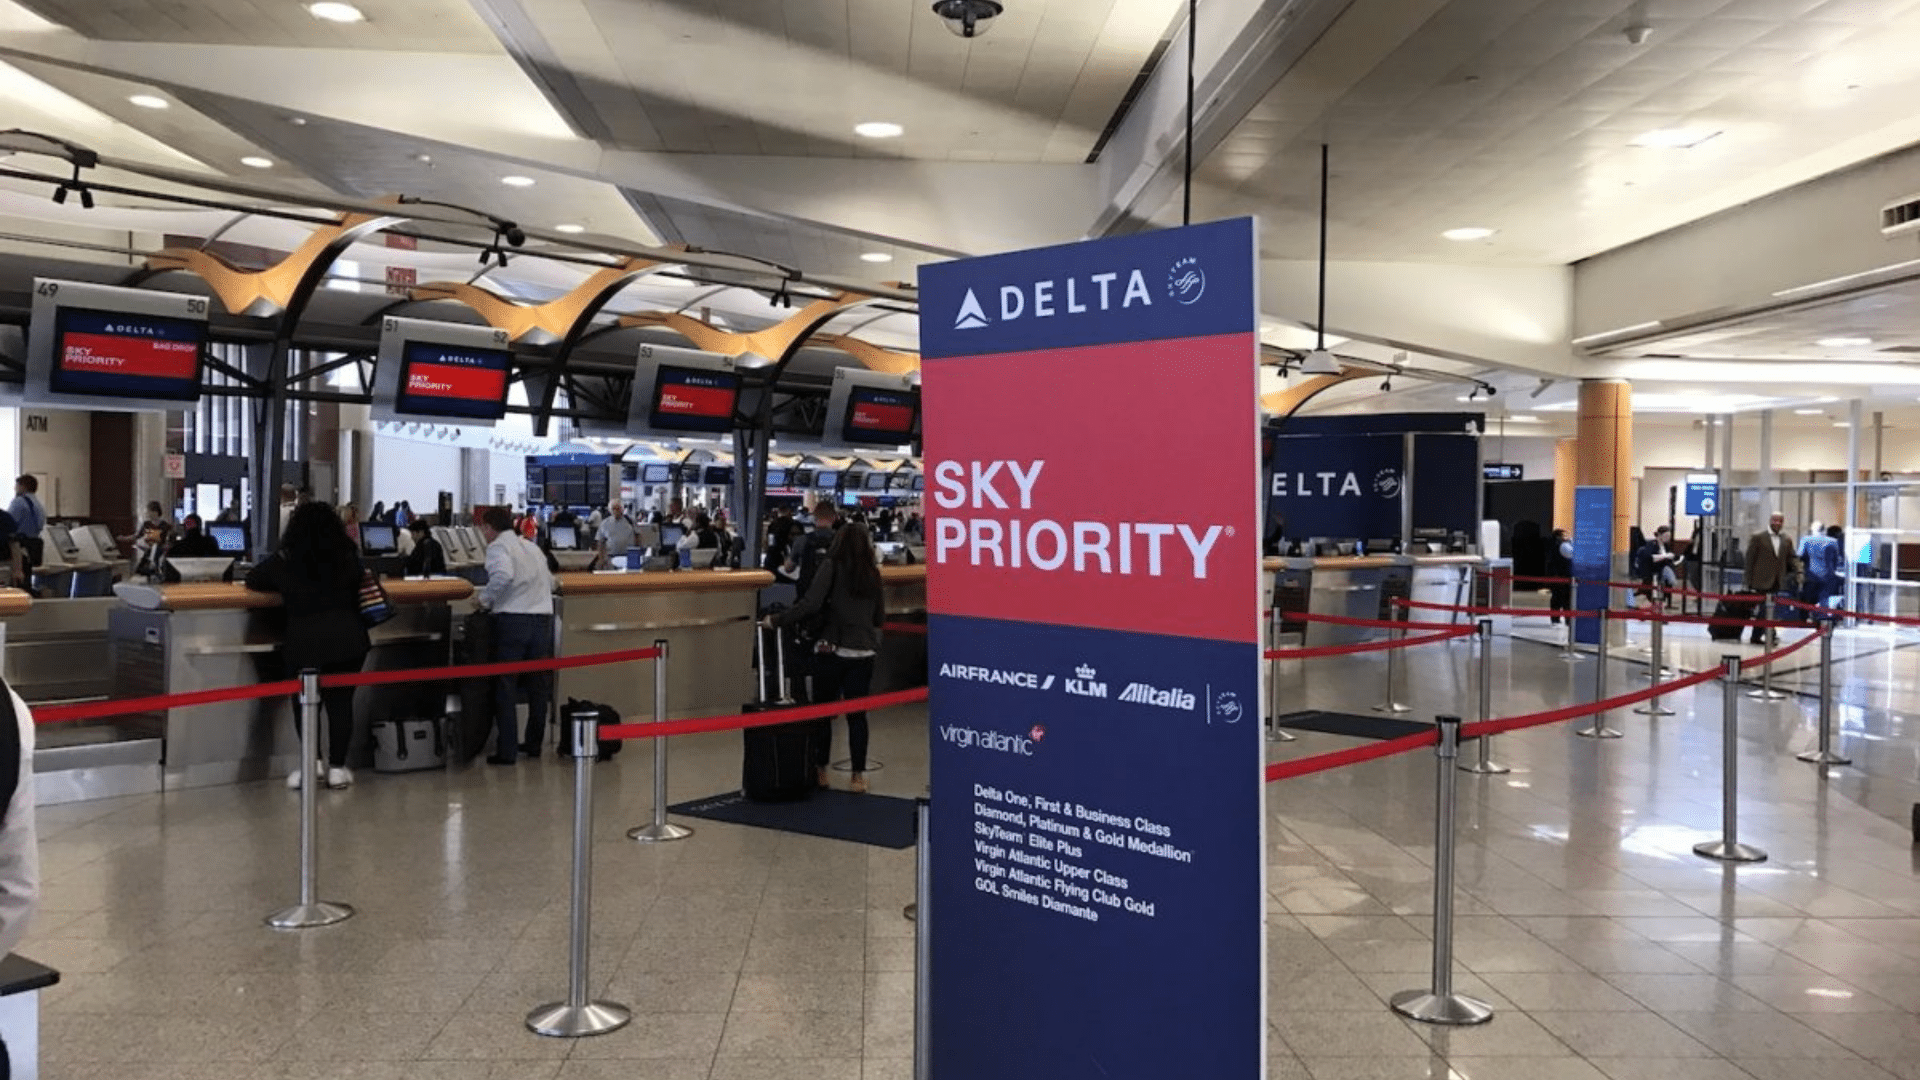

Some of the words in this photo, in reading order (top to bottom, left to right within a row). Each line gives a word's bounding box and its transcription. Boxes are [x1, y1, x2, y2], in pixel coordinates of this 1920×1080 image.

[37, 283, 59, 298] 49
[1000, 269, 1152, 320] DELTA
[187, 299, 206, 314] 50
[116, 325, 154, 335] DELTA
[385, 319, 399, 333] 51
[493, 331, 508, 343] 52
[64, 355, 125, 367] PRIORITY
[65, 346, 93, 356] SKY
[447, 355, 475, 365] DELTA
[26, 415, 48, 432] ATM
[934, 459, 1045, 509] SKY
[1271, 472, 1362, 496] ELTA
[935, 518, 1224, 579] PRIORITY
[1065, 678, 1108, 698] KLM
[1118, 682, 1196, 711] Alitalia
[974, 783, 1003, 801] Delta
[1035, 796, 1061, 814] First
[1063, 802, 1073, 817] &
[1075, 804, 1131, 829] Business
[1134, 817, 1171, 837] Class
[974, 802, 1027, 828] Diamond,
[1029, 813, 1080, 838] Platinum
[1083, 826, 1092, 841] &
[1095, 829, 1125, 848] Gold
[1127, 836, 1192, 863] Medallion
[974, 821, 1023, 844] SkyTeam
[1028, 833, 1054, 851] Elite
[1057, 840, 1083, 858] Plus
[974, 839, 1006, 860] Virgin
[1008, 847, 1051, 870] Atlantic
[1054, 858, 1091, 881] Upper
[1093, 869, 1129, 890] Class
[974, 858, 1006, 879] Virgin
[1008, 867, 1051, 890] Atlantic
[1054, 878, 1089, 902] Flying
[1092, 888, 1121, 908] Club
[1124, 896, 1155, 917] Gold
[974, 877, 1000, 895] GOL
[1001, 883, 1039, 905] Smiles
[1042, 894, 1098, 922] Diamante
